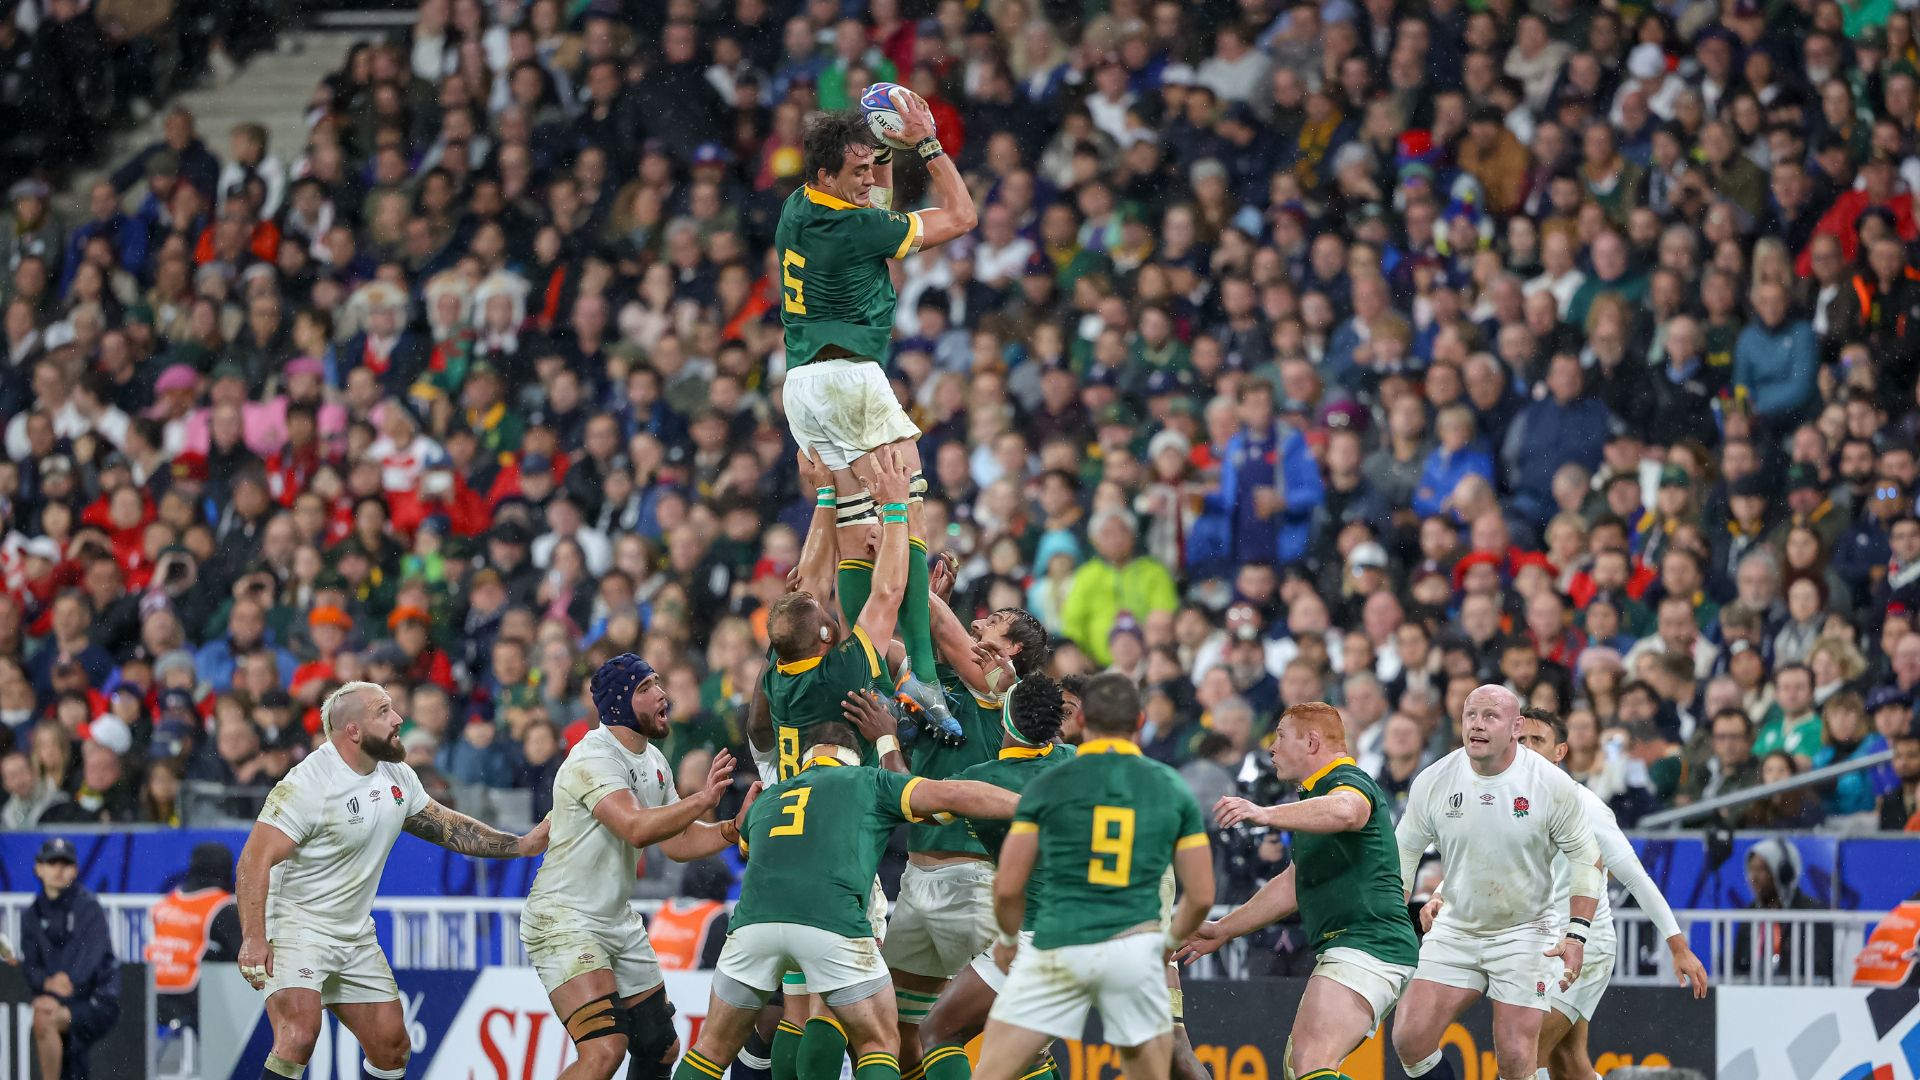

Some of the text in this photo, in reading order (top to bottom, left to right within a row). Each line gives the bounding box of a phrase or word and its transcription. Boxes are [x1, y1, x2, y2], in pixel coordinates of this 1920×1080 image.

[782, 248, 807, 315] 5
[778, 725, 800, 782] 8
[768, 786, 812, 838] 3
[1087, 804, 1136, 888] 9
